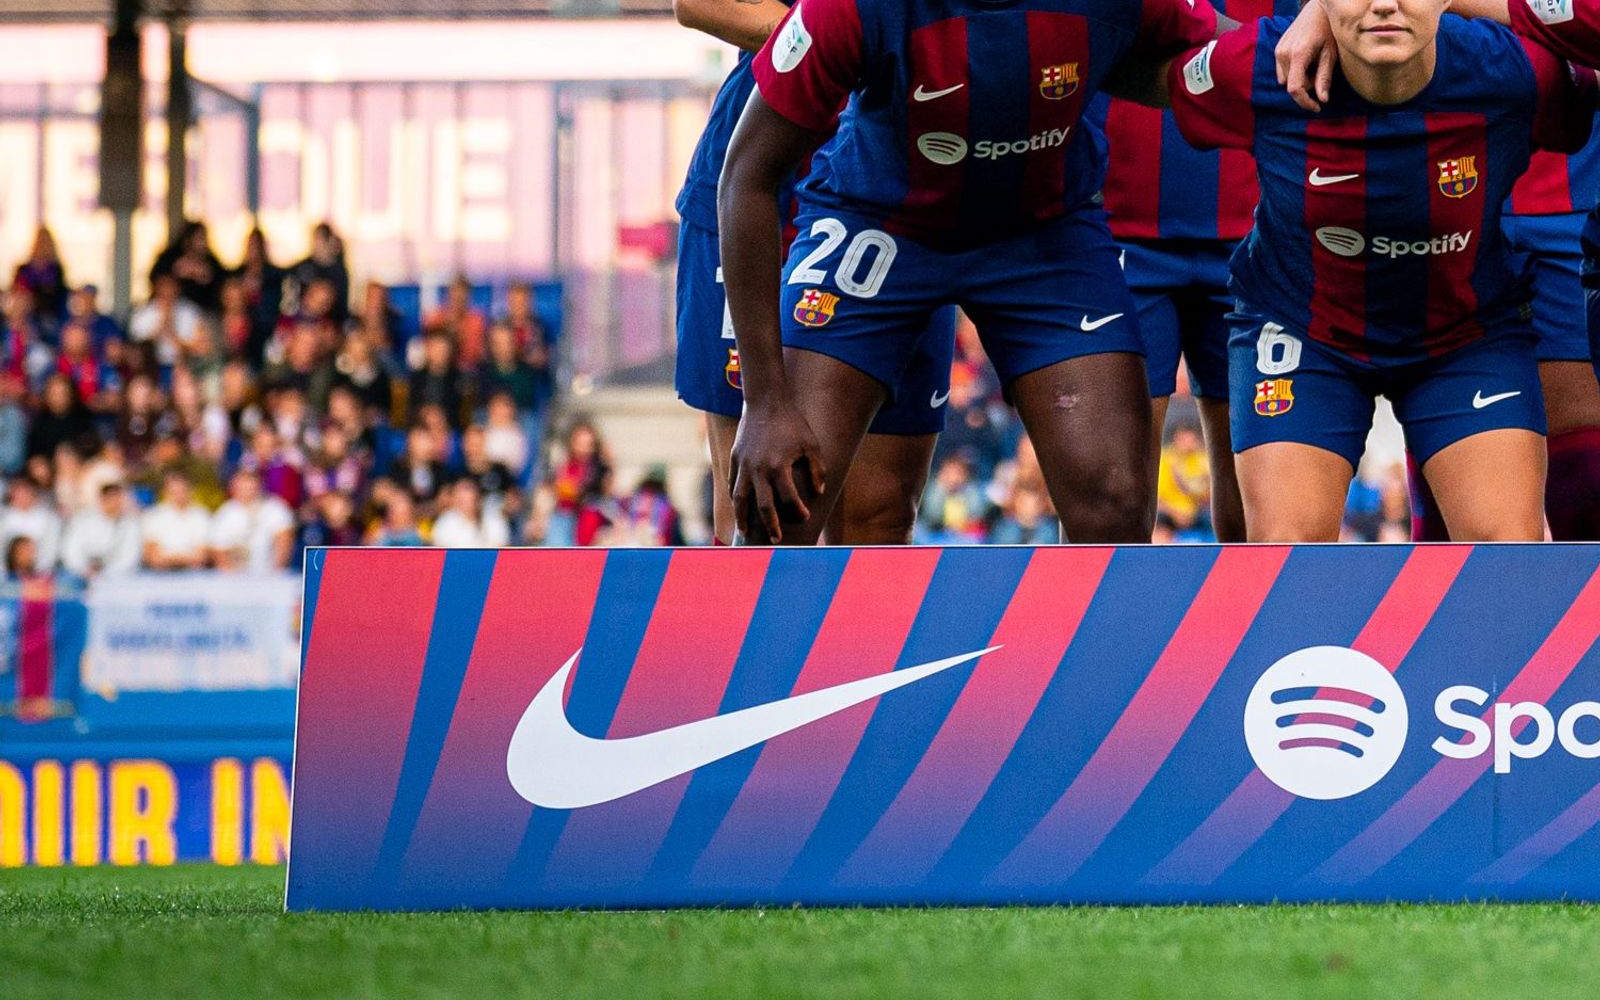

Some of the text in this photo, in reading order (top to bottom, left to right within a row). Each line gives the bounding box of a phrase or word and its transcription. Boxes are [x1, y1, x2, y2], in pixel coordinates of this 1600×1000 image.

[973, 126, 1070, 160] Spotify
[787, 218, 898, 298] 20
[1371, 230, 1472, 258] Spotify
[1256, 321, 1302, 375] 6
